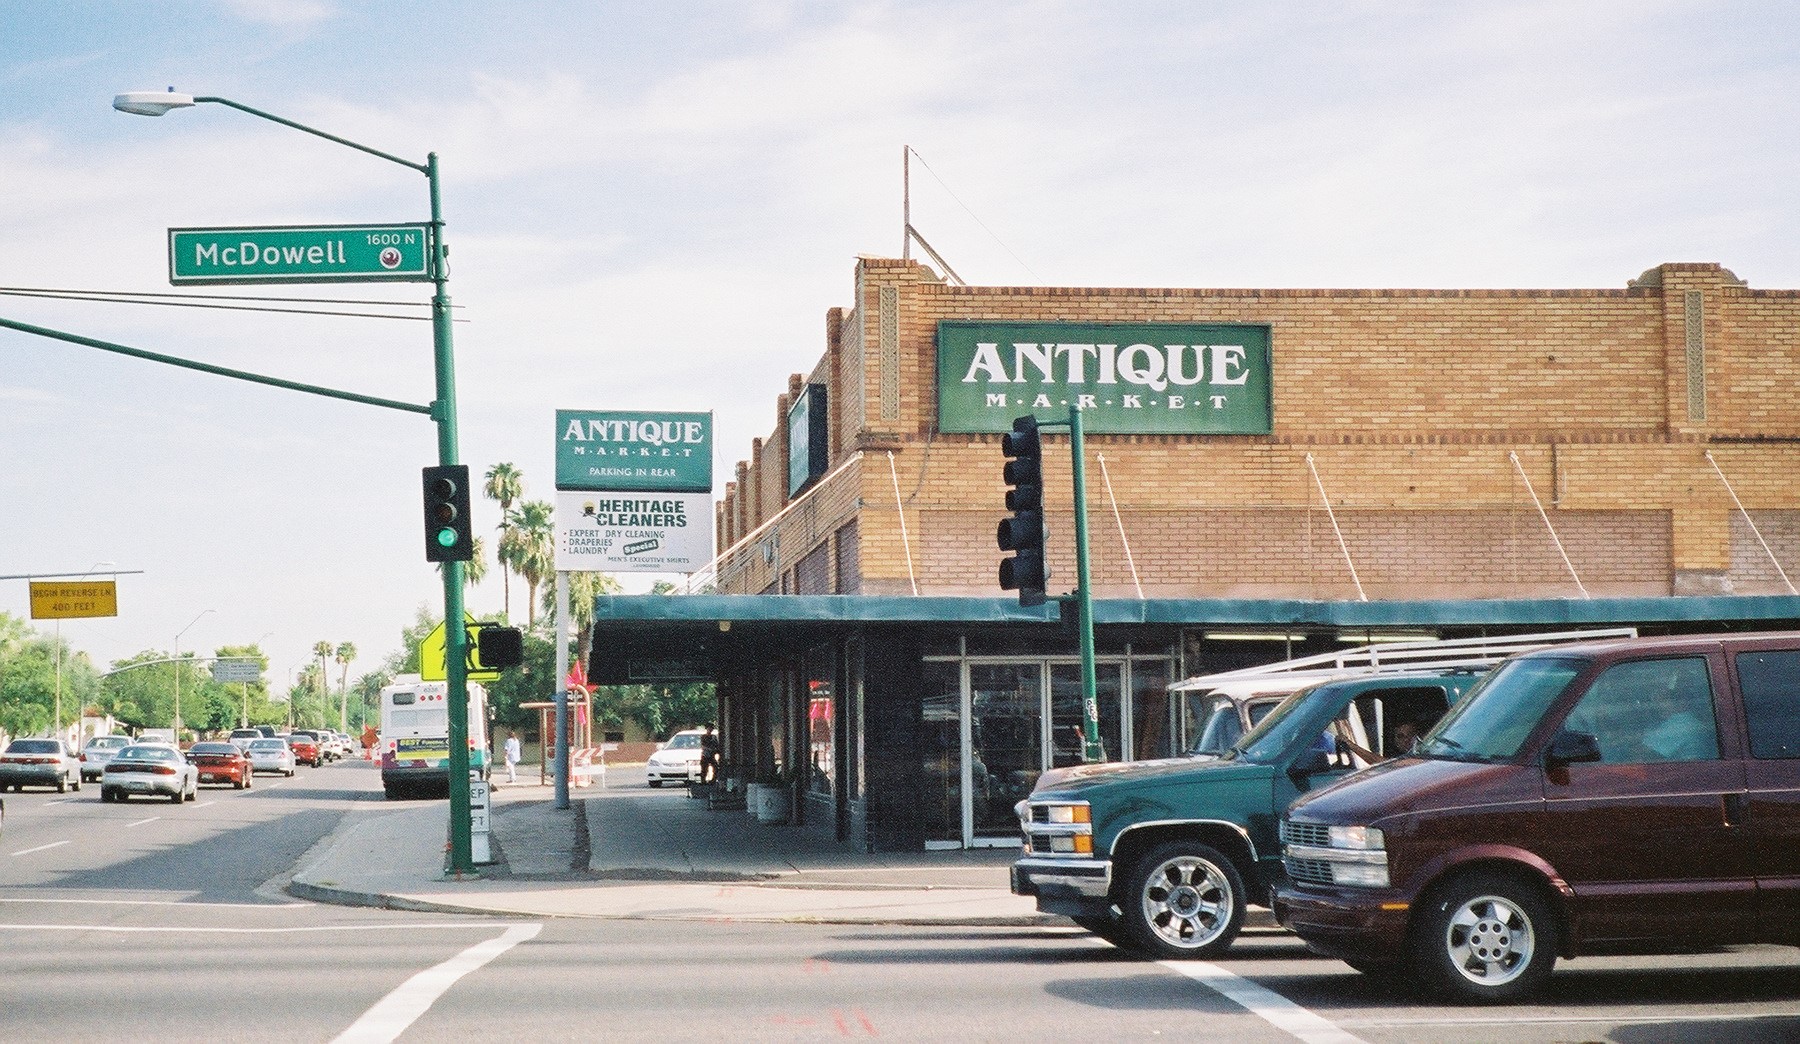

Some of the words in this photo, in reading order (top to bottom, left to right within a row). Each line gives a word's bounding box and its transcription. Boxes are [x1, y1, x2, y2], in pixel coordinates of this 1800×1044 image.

[366, 233, 401, 245] 1600
[405, 233, 415, 244] N
[195, 240, 347, 267] McDowell
[961, 342, 1250, 391] ANTIQUE
[563, 419, 704, 446] ANTIQUE
[589, 467, 632, 477] PARKING
[636, 468, 647, 476] IN
[651, 468, 676, 477] REAR
[599, 499, 685, 514] HERITAGE
[596, 513, 687, 527] CLEANERS
[569, 529, 600, 538] EXPERT
[605, 529, 622, 538] DRY
[625, 530, 665, 538] CLEANING
[569, 538, 613, 546] DRAPERIES
[624, 540, 657, 554] Special
[568, 547, 608, 555] LAUNDRY
[33, 589, 58, 598] BEGIN
[60, 588, 98, 597] REVERSE
[52, 602, 70, 611] 400
[74, 602, 95, 611] FEET
[470, 788, 485, 798] EP
[470, 816, 484, 826] FT
